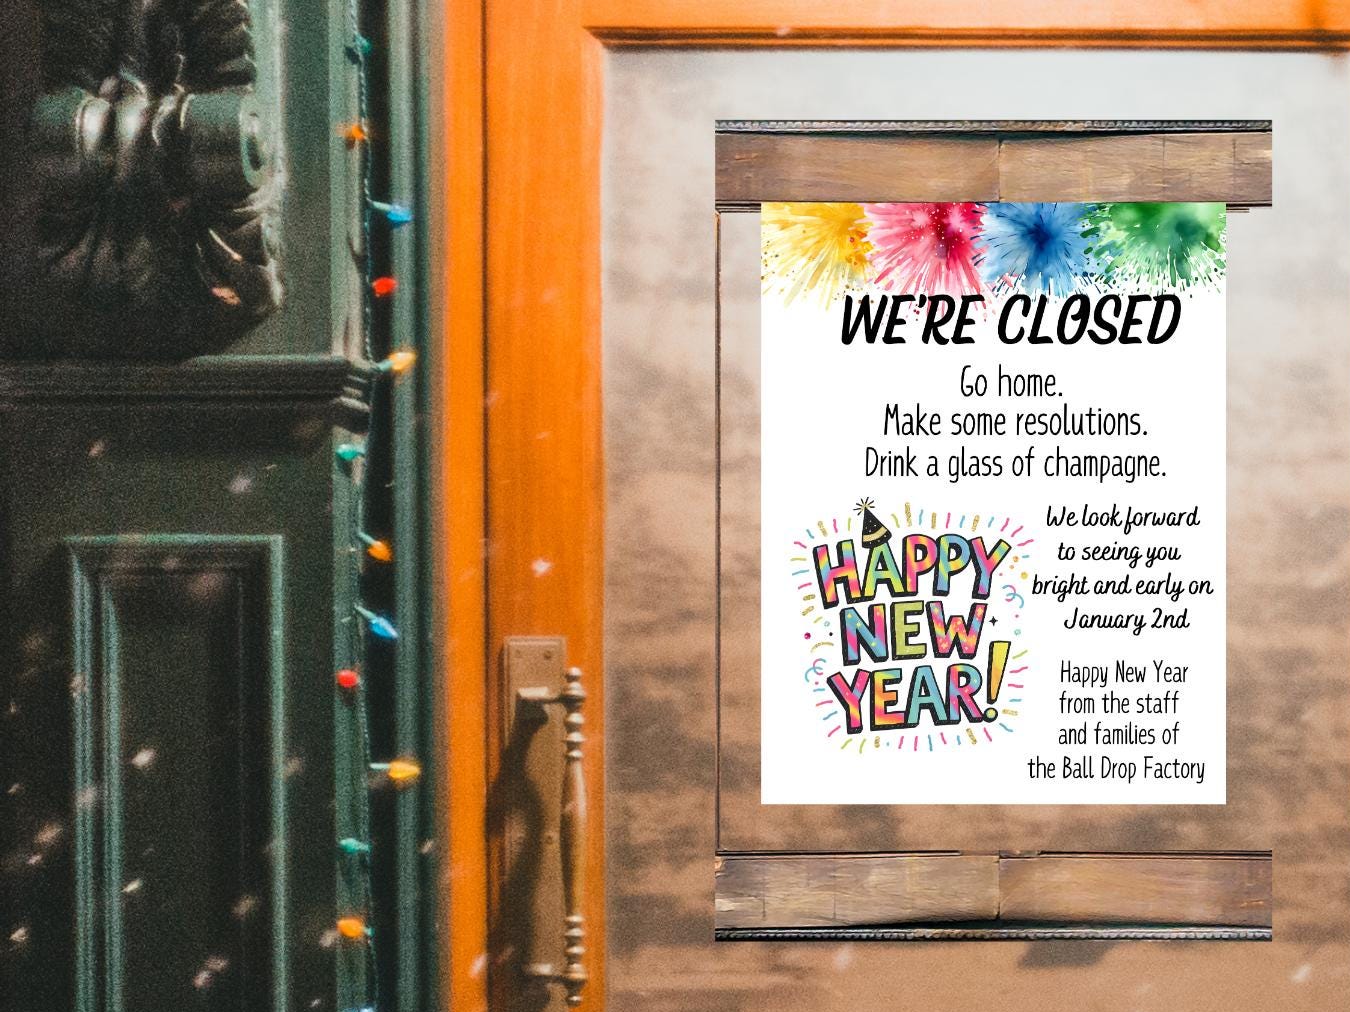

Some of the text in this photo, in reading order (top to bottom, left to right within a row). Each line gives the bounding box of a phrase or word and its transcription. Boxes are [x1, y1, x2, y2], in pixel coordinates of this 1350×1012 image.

[841, 293, 1182, 346] WE'RE CLOSED
[960, 363, 1063, 397] Go home.
[883, 402, 1148, 436] Make some resolutions.
[865, 445, 1166, 484] Drink a glass of champagne.
[1046, 503, 1201, 536] We look forward
[813, 534, 1012, 609] HAPPY
[1057, 542, 1182, 569] to seeing you
[1031, 572, 1214, 603] bright and early on
[840, 600, 988, 666] NEW
[1063, 607, 1191, 636] January 2nd
[826, 640, 1012, 734] YEAR!
[1060, 659, 1189, 688] Happy New Year
[1059, 690, 1179, 714] from the staff
[1058, 721, 1180, 745] and families of
[1027, 755, 1205, 784] the Ball Drop Factory
